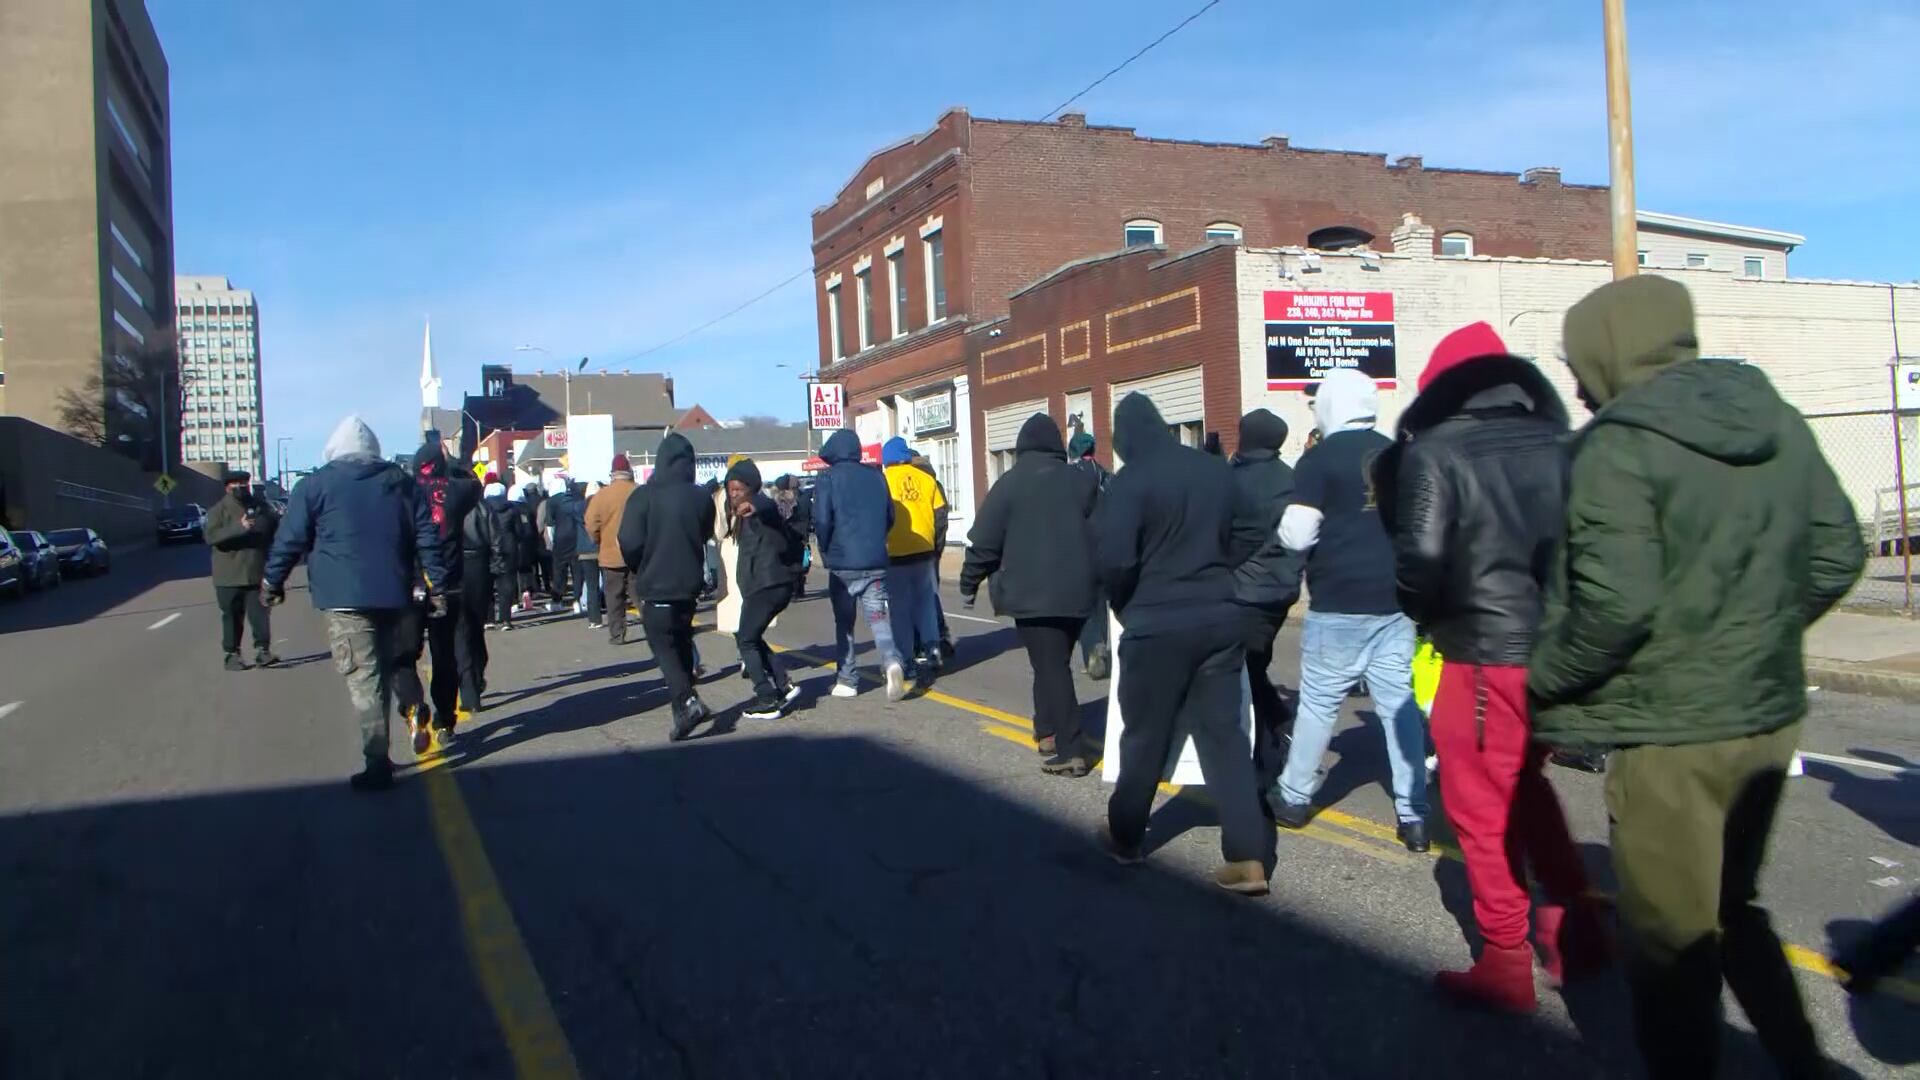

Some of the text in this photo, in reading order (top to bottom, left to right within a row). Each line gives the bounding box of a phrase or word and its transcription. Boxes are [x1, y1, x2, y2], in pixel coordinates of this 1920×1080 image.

[1293, 295, 1366, 307] PARKING FOR ONLY
[1304, 308, 1321, 319] 240,
[1321, 308, 1335, 318] 242
[1336, 308, 1359, 320] Poplar
[1360, 309, 1374, 318] Ave
[1309, 326, 1352, 336] Law Offices
[1267, 336, 1394, 349] All N One Bonding & Insurance Inc.
[1295, 347, 1370, 357] All N One Bail Bonds
[1304, 357, 1359, 368] A-1 Bail Bonds
[814, 385, 839, 402] A-1
[814, 404, 841, 416] BAIL
[814, 417, 841, 427] BONDS
[697, 456, 728, 469] RRON
